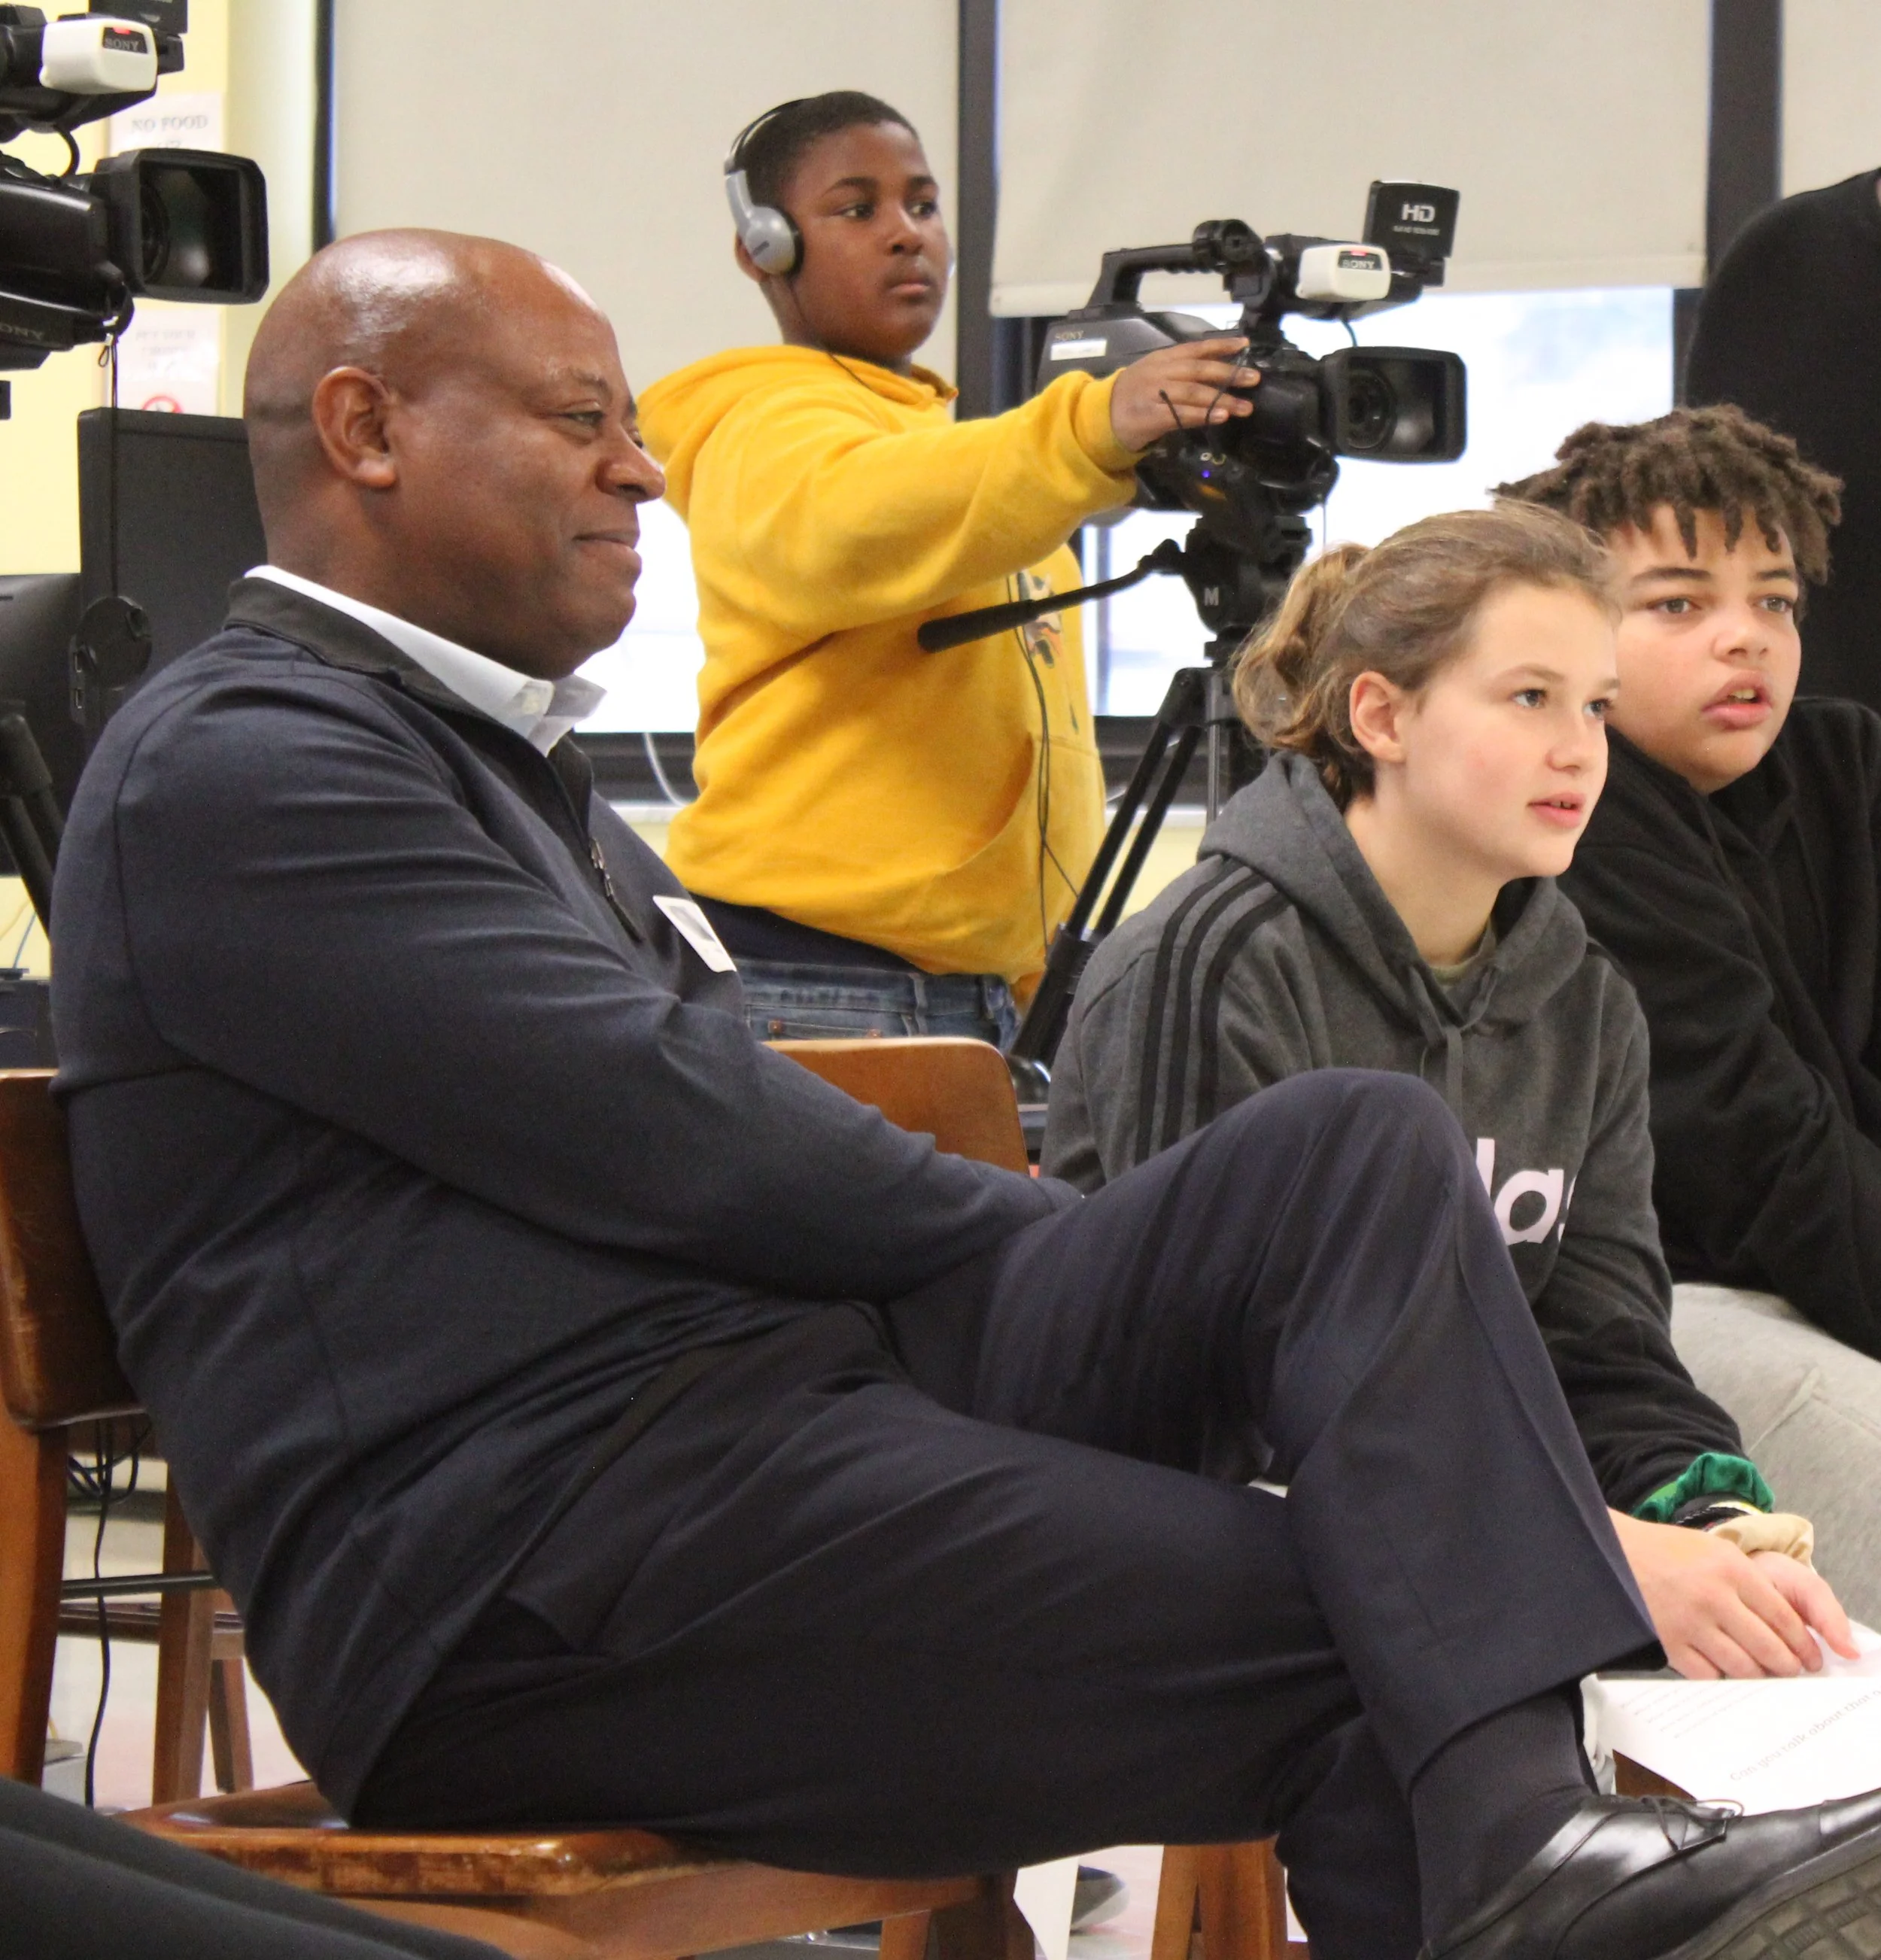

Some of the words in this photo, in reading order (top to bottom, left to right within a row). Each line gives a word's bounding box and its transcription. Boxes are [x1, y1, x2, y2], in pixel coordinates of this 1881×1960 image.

[105, 38, 139, 51] SONY
[132, 118, 156, 132] NO
[161, 114, 209, 132] FOOD
[1402, 203, 1435, 222] HD
[1342, 259, 1375, 269] SONY
[0, 323, 44, 340] ONY
[1055, 330, 1084, 341] SONY
[1730, 1766, 1758, 1781] Can
[1758, 1750, 1782, 1768] you
[1780, 1734, 1807, 1752] talk
[1809, 1710, 1845, 1736] about
[1843, 1694, 1871, 1712] that
